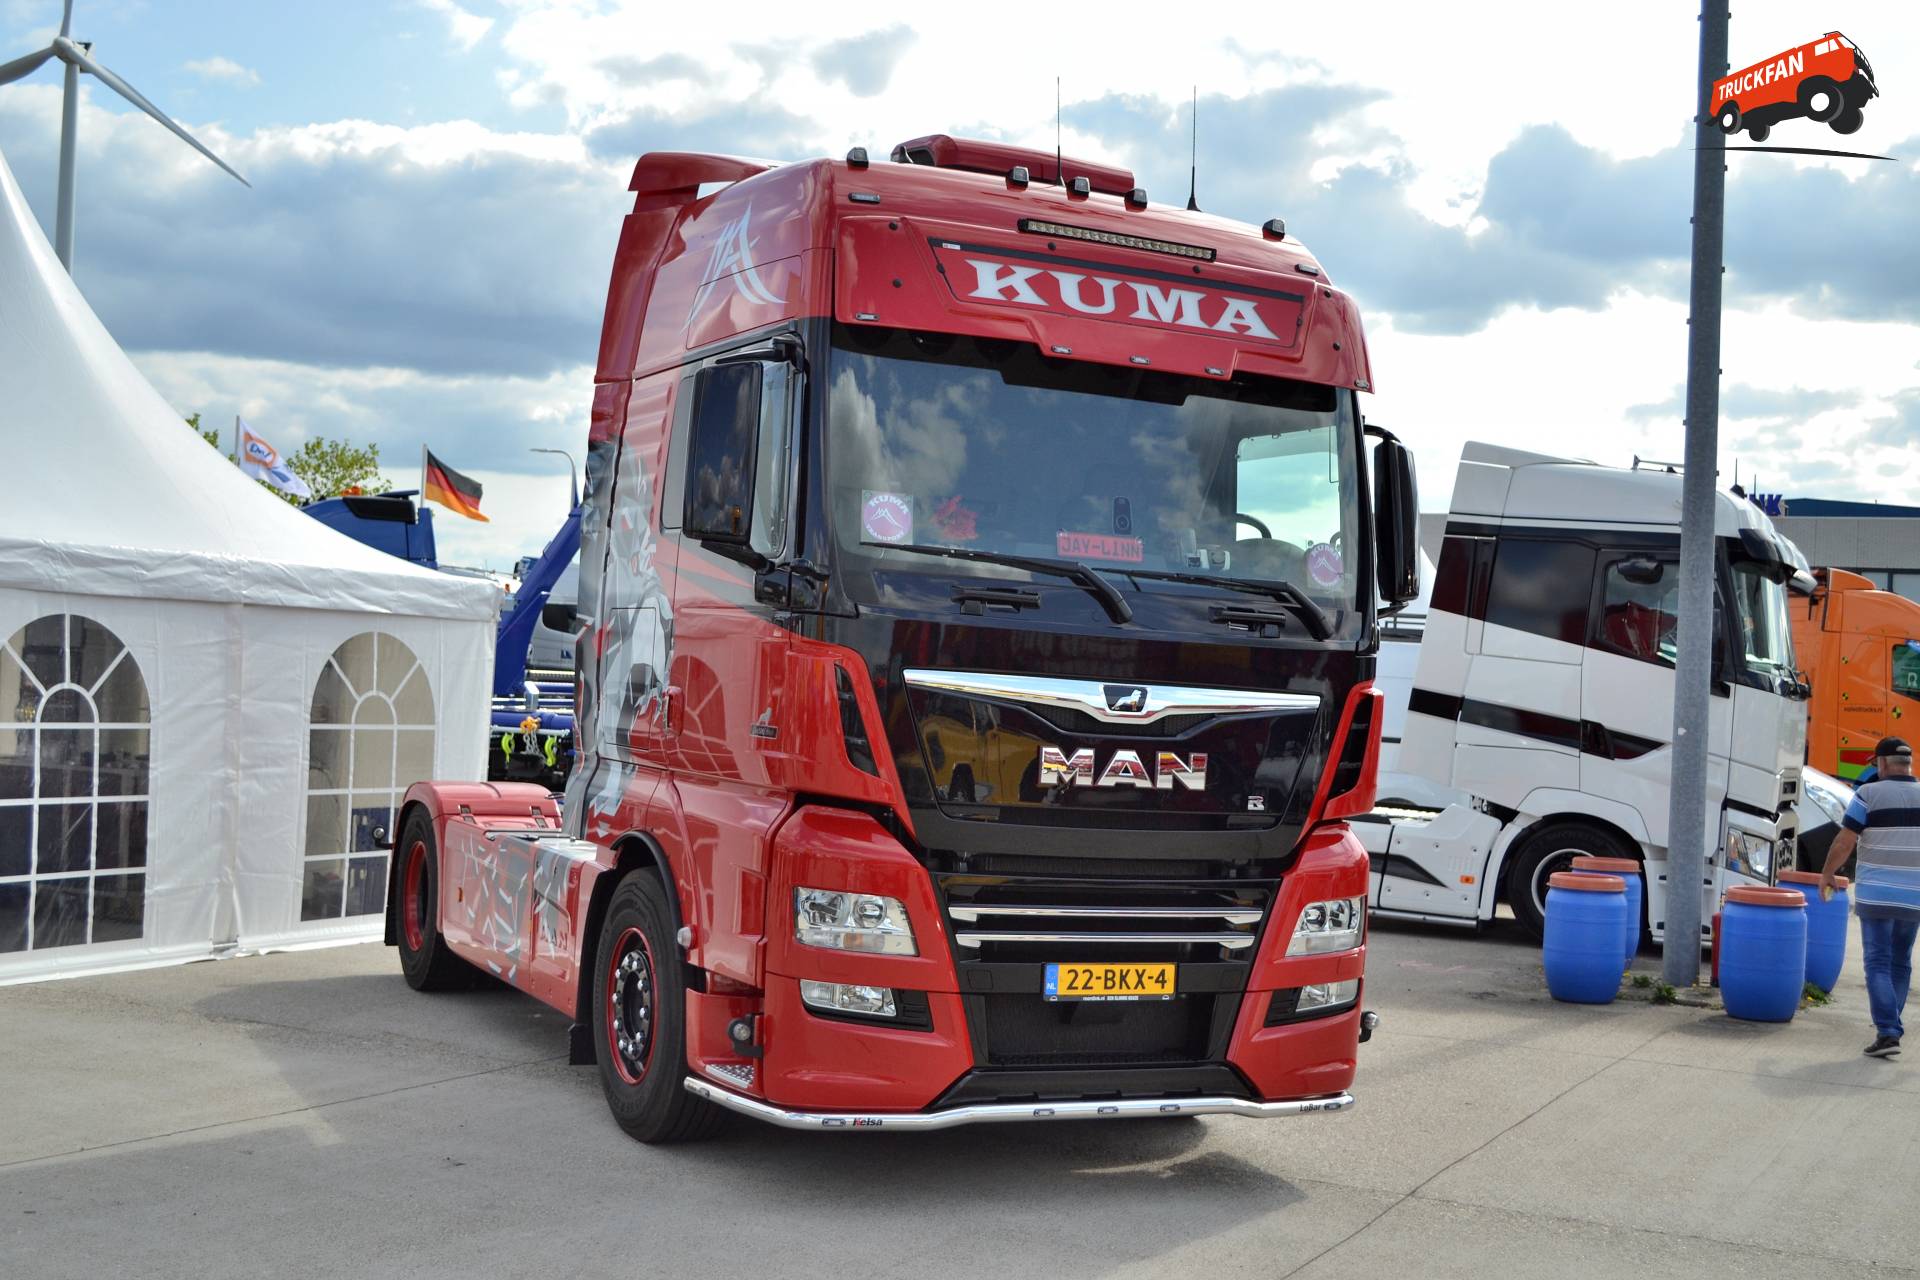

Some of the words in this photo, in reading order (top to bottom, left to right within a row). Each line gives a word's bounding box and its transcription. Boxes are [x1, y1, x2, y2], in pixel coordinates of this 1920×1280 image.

[965, 259, 1280, 340] KUMA
[869, 495, 910, 515] KUMA
[1062, 537, 1140, 558] JAY-LINN
[1039, 745, 1209, 791] MAN
[1046, 982, 1056, 990] NL
[1066, 968, 1168, 990] 22-BKX-4
